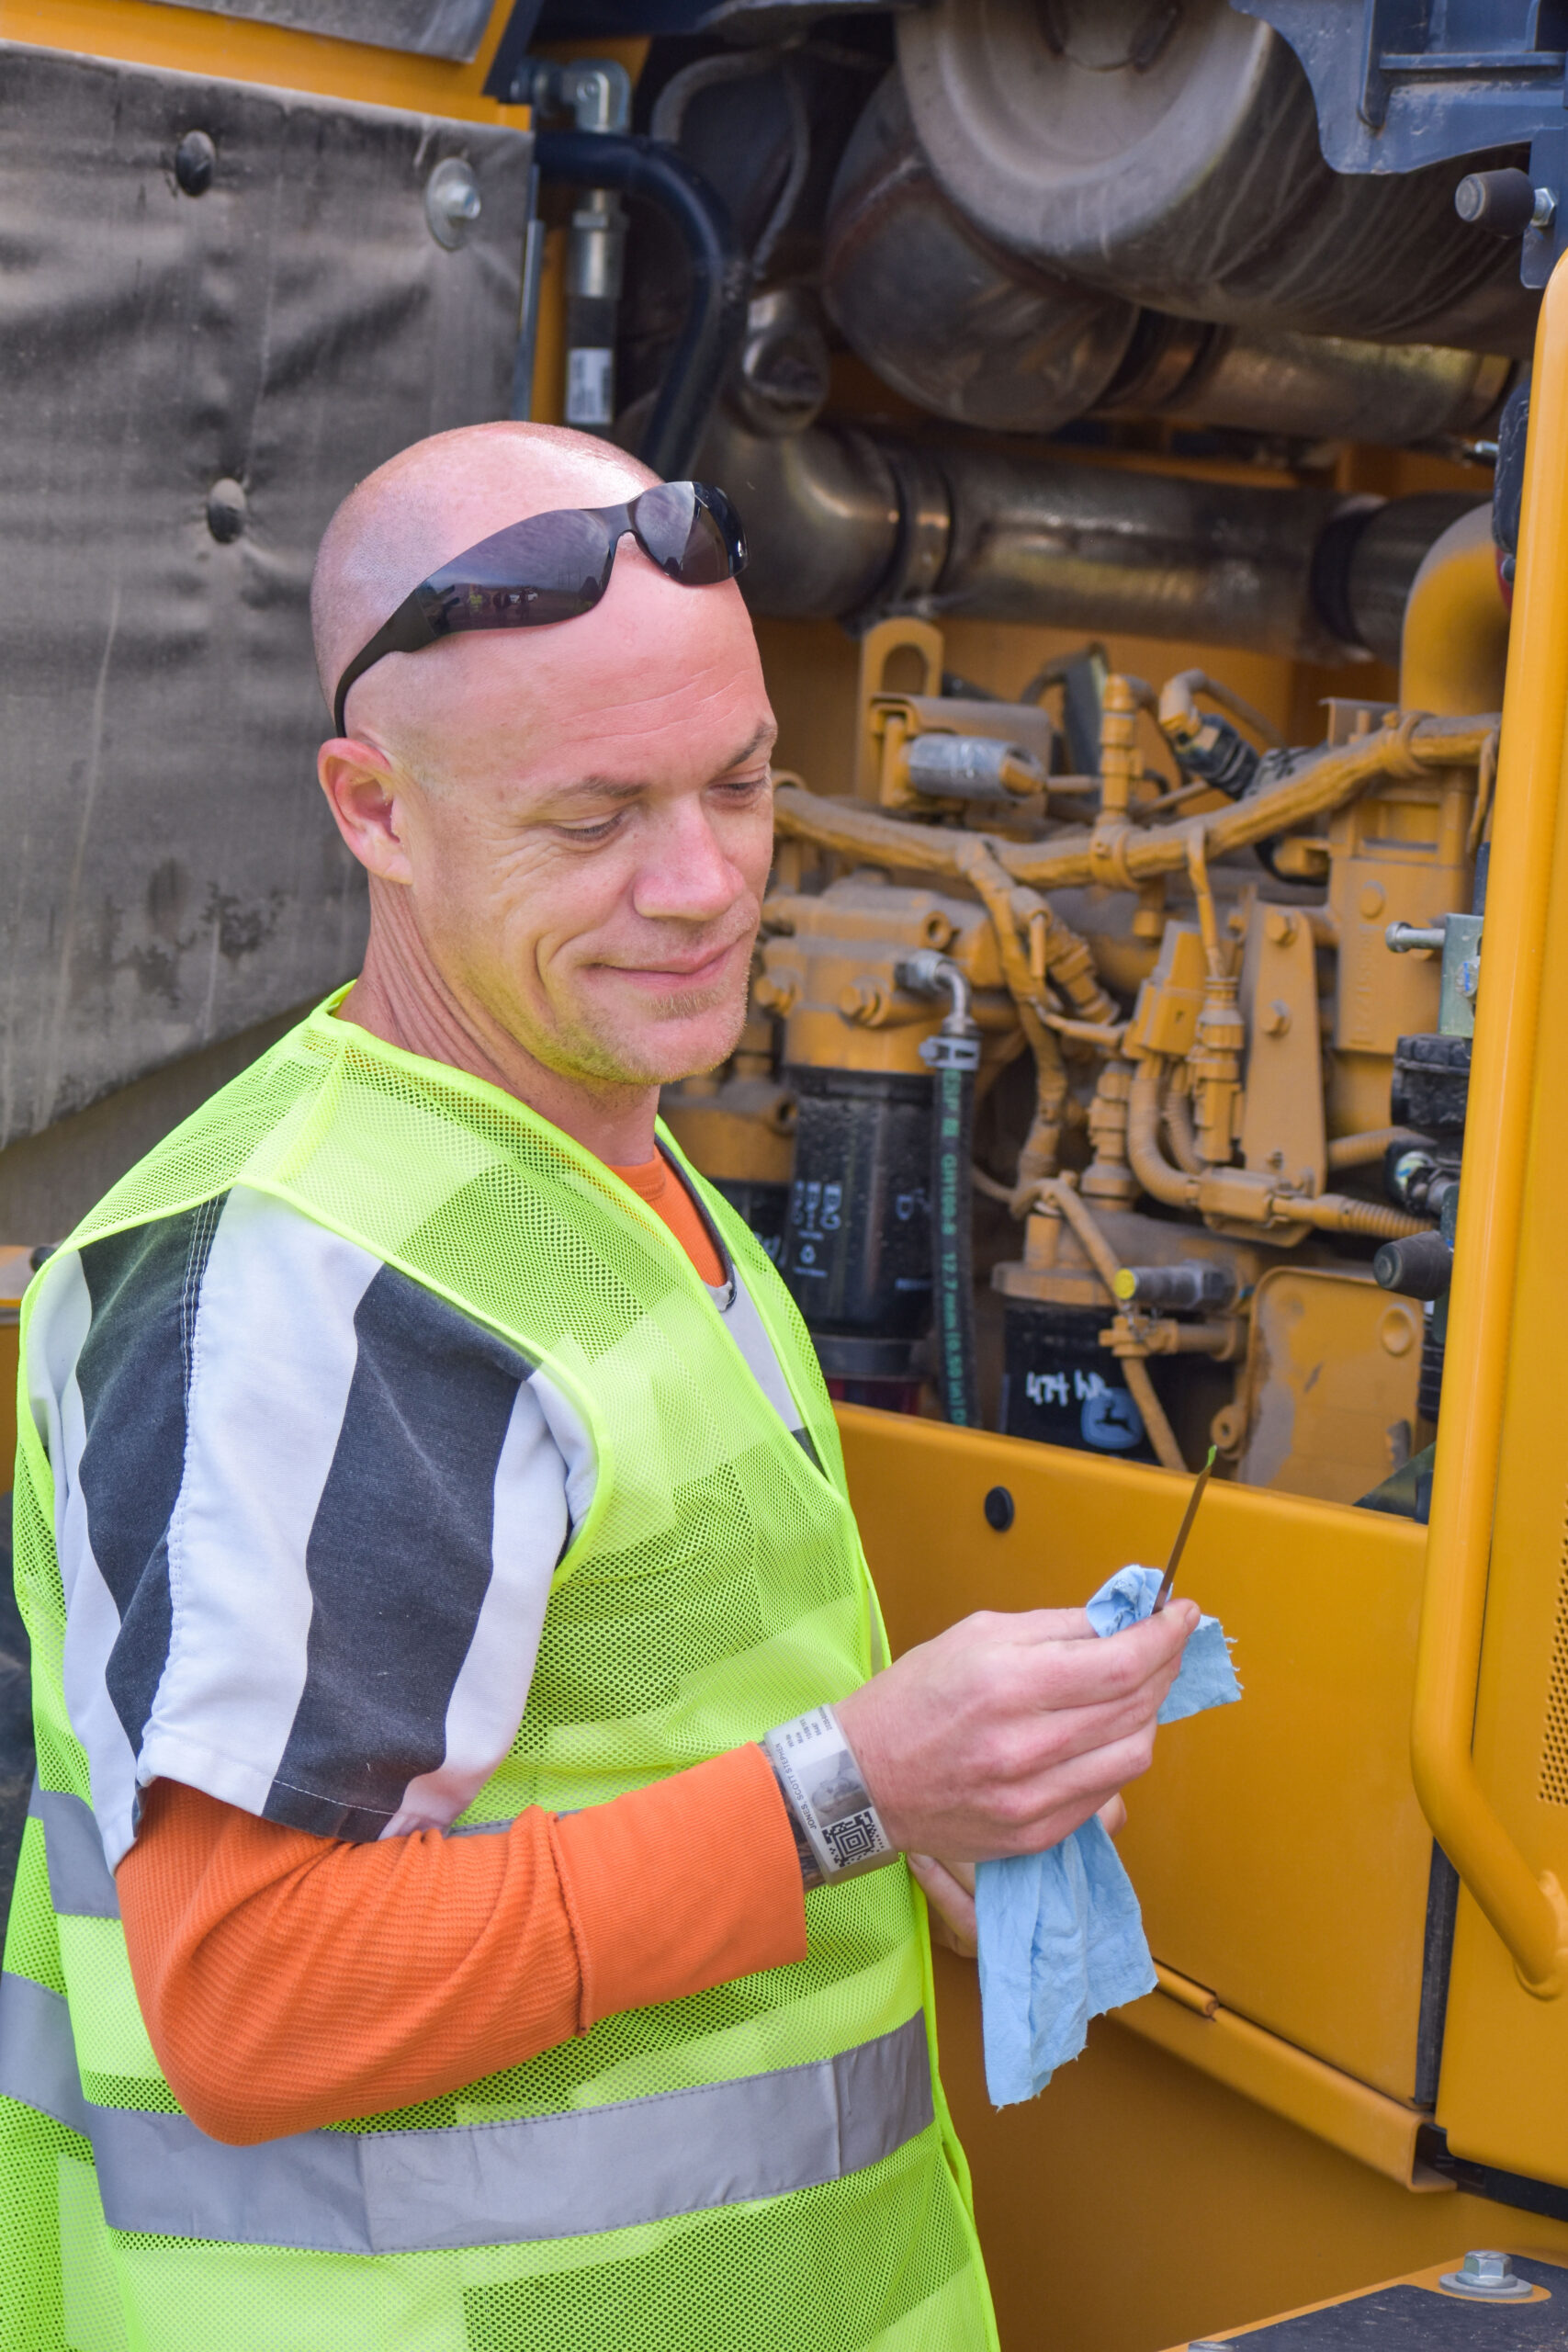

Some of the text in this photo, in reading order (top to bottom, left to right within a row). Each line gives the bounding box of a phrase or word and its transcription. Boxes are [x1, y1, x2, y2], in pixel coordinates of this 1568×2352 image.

[1026, 1371, 1070, 1407] 474
[775, 1742, 818, 1831] JONES, SCOTT STEPHEN
